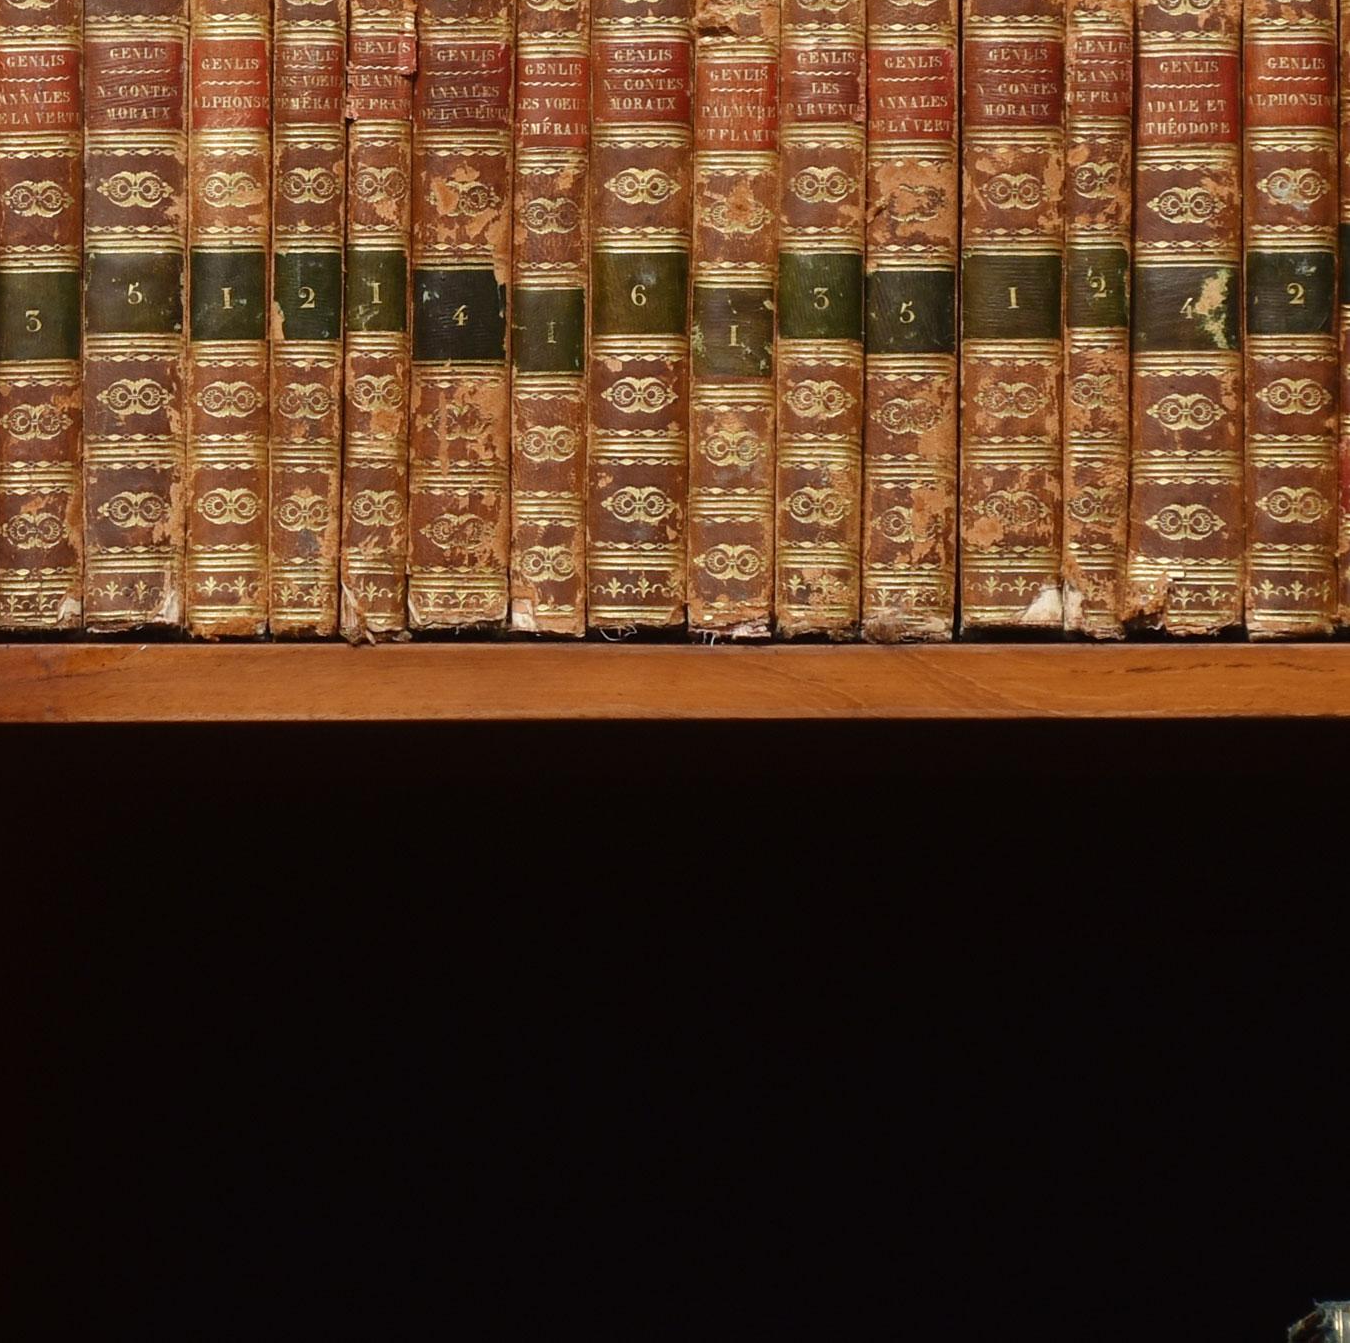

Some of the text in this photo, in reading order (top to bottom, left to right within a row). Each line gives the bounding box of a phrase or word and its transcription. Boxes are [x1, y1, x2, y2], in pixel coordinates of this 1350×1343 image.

[109, 47, 167, 59] GENLIS
[437, 49, 496, 62] GENLIS
[615, 49, 673, 62] GENLIS
[797, 51, 857, 64] GENLIS
[988, 49, 1048, 61] GENLIS
[6, 54, 65, 67] GENLIS
[201, 58, 259, 70] GENLIS
[885, 56, 943, 69] GENLIS
[1159, 60, 1219, 73] GENLIS
[1267, 57, 1326, 70] GENLIS
[525, 63, 582, 75] GENLIS
[710, 69, 768, 81] GENLIS
[624, 79, 684, 90] CONTES
[811, 82, 840, 94] LES
[998, 83, 1058, 95] CONTES
[119, 85, 178, 98] CONTES
[610, 97, 676, 110] MORAUX
[878, 96, 948, 108] ANNALES
[1147, 99, 1227, 113] ADALE ET
[106, 107, 171, 120] MORAUX
[985, 104, 1050, 116] MORAUX
[11, 112, 30, 124] LA
[888, 120, 907, 132] LA
[1146, 118, 1231, 134] THÉODORE
[1090, 274, 1107, 298] 2
[127, 282, 143, 305] 5
[298, 286, 316, 309] 2
[630, 284, 647, 306] 6
[813, 287, 830, 310] 3
[1286, 282, 1305, 305] 2
[899, 301, 915, 324] 5
[1179, 297, 1195, 320] 4
[25, 310, 42, 333] 3
[452, 304, 469, 327] 4
